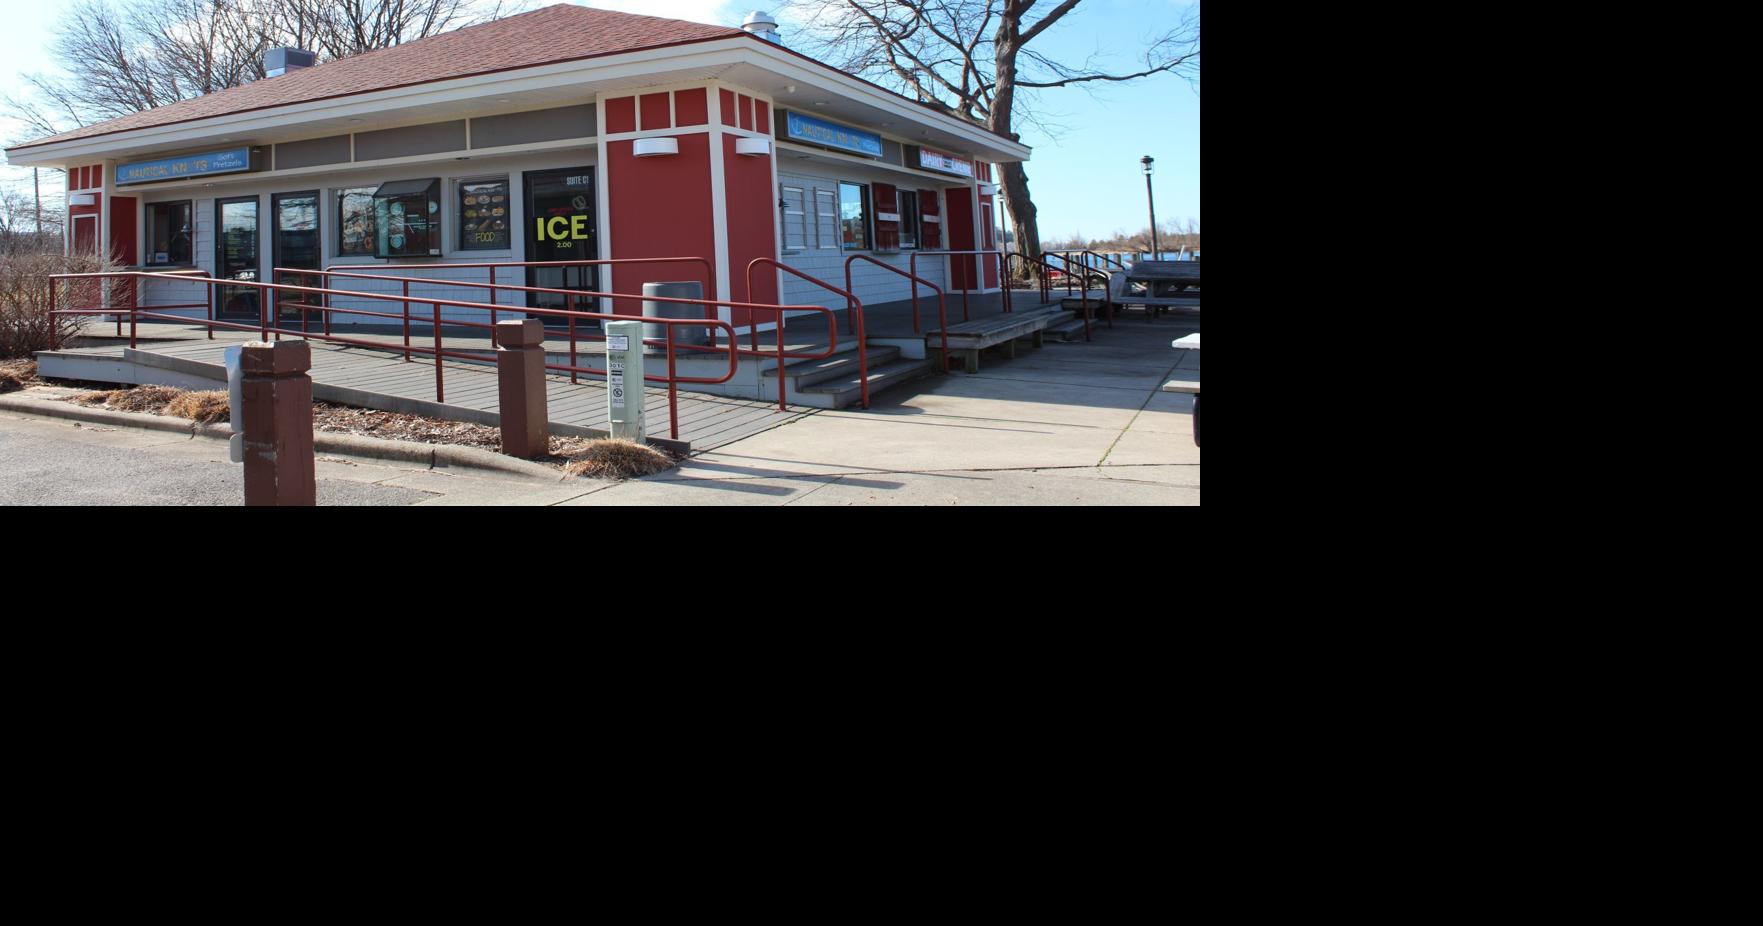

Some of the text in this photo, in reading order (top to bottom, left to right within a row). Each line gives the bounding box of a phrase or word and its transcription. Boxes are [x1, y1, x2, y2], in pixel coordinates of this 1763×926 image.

[566, 175, 582, 185] SUITE
[537, 215, 588, 241] ICE
[475, 231, 496, 243] FOOD
